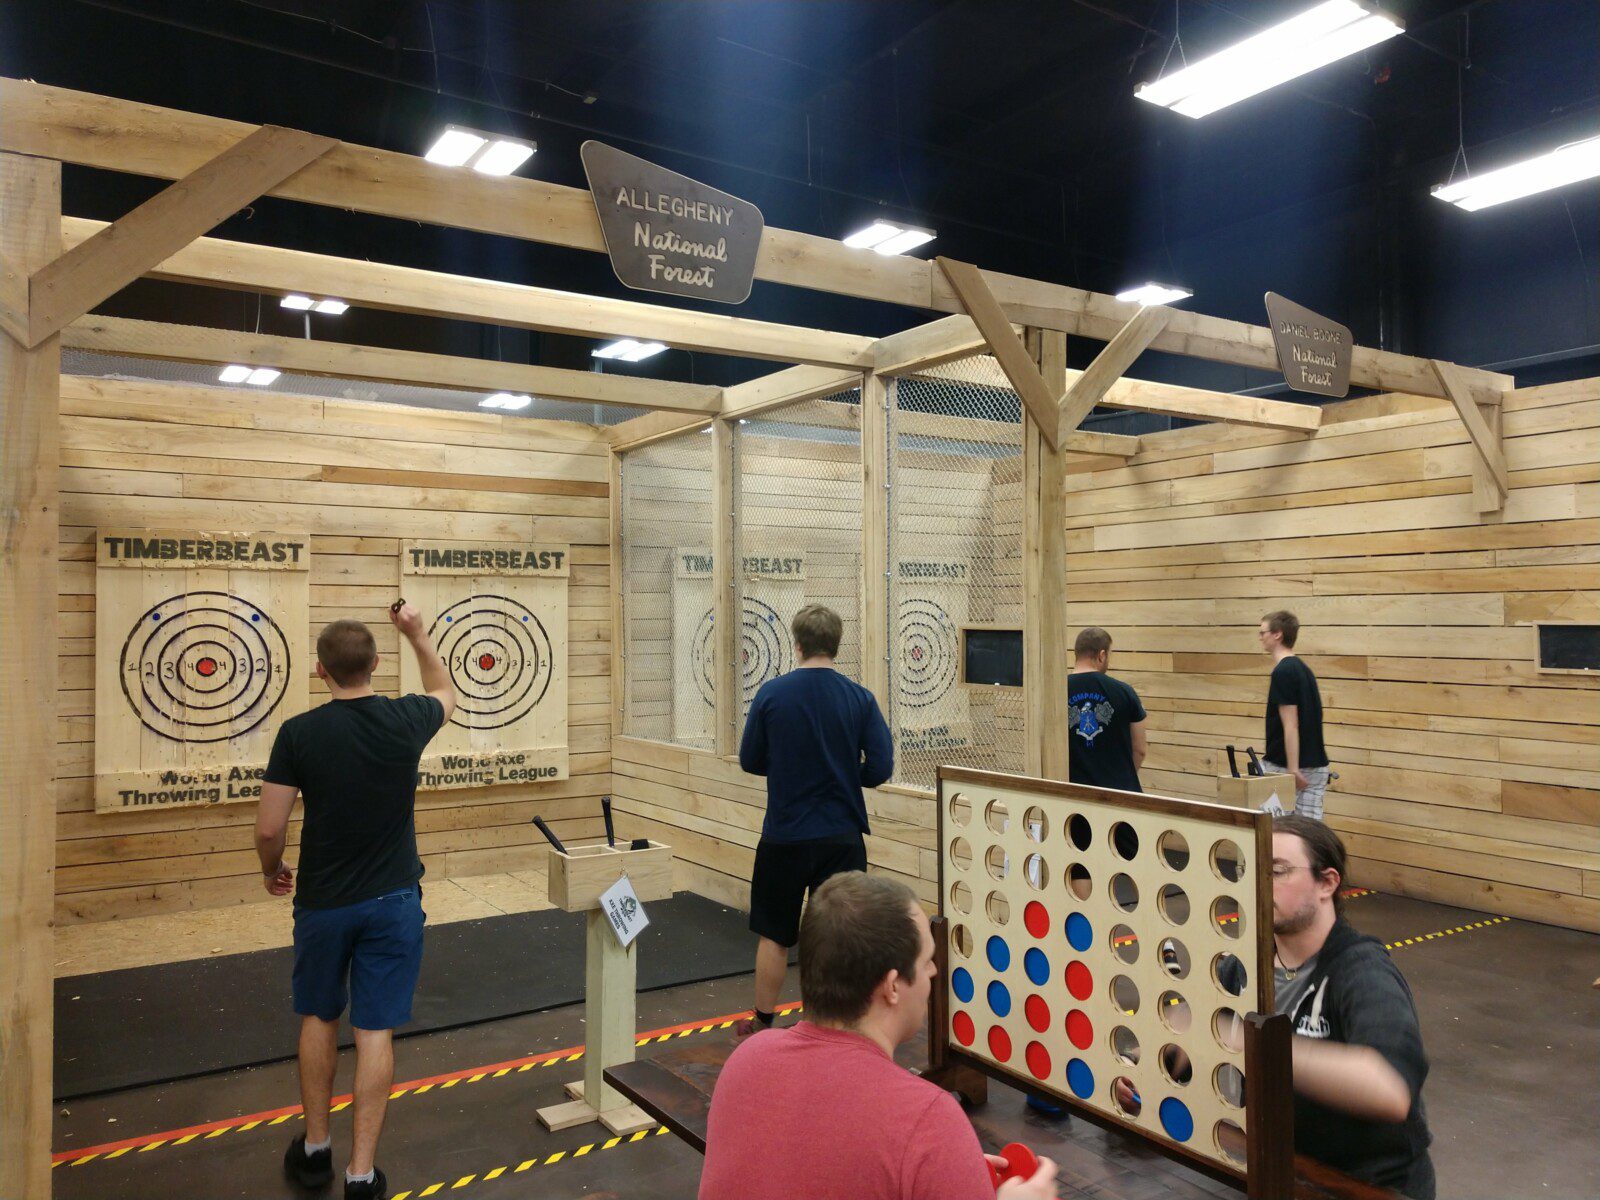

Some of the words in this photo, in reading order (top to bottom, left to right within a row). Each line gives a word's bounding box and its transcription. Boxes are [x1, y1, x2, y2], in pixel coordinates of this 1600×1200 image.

[616, 187, 734, 226] ALLEGHENY
[634, 221, 728, 262] National
[648, 254, 716, 288] Forest
[1280, 321, 1310, 339] DANIEL
[1313, 328, 1342, 344] BOONE
[1292, 343, 1337, 368] National
[1300, 365, 1332, 386] Forest
[104, 537, 304, 563] TIMBERBEAST
[409, 548, 566, 570] TIMBERBEAST
[127, 662, 137, 672] 1
[145, 661, 155, 677] 2
[163, 661, 175, 680] 3
[187, 662, 194, 671] 4
[219, 661, 227, 670] 4
[238, 658, 247, 675] 3
[255, 657, 266, 673] 2
[455, 656, 462, 671] 3
[472, 657, 478, 666] 4
[496, 656, 502, 665] 4
[512, 659, 518, 667] 3
[228, 766, 267, 781] Axe
[499, 766, 558, 781] League
[118, 786, 220, 806] Throwing
[227, 783, 262, 799] Lea
